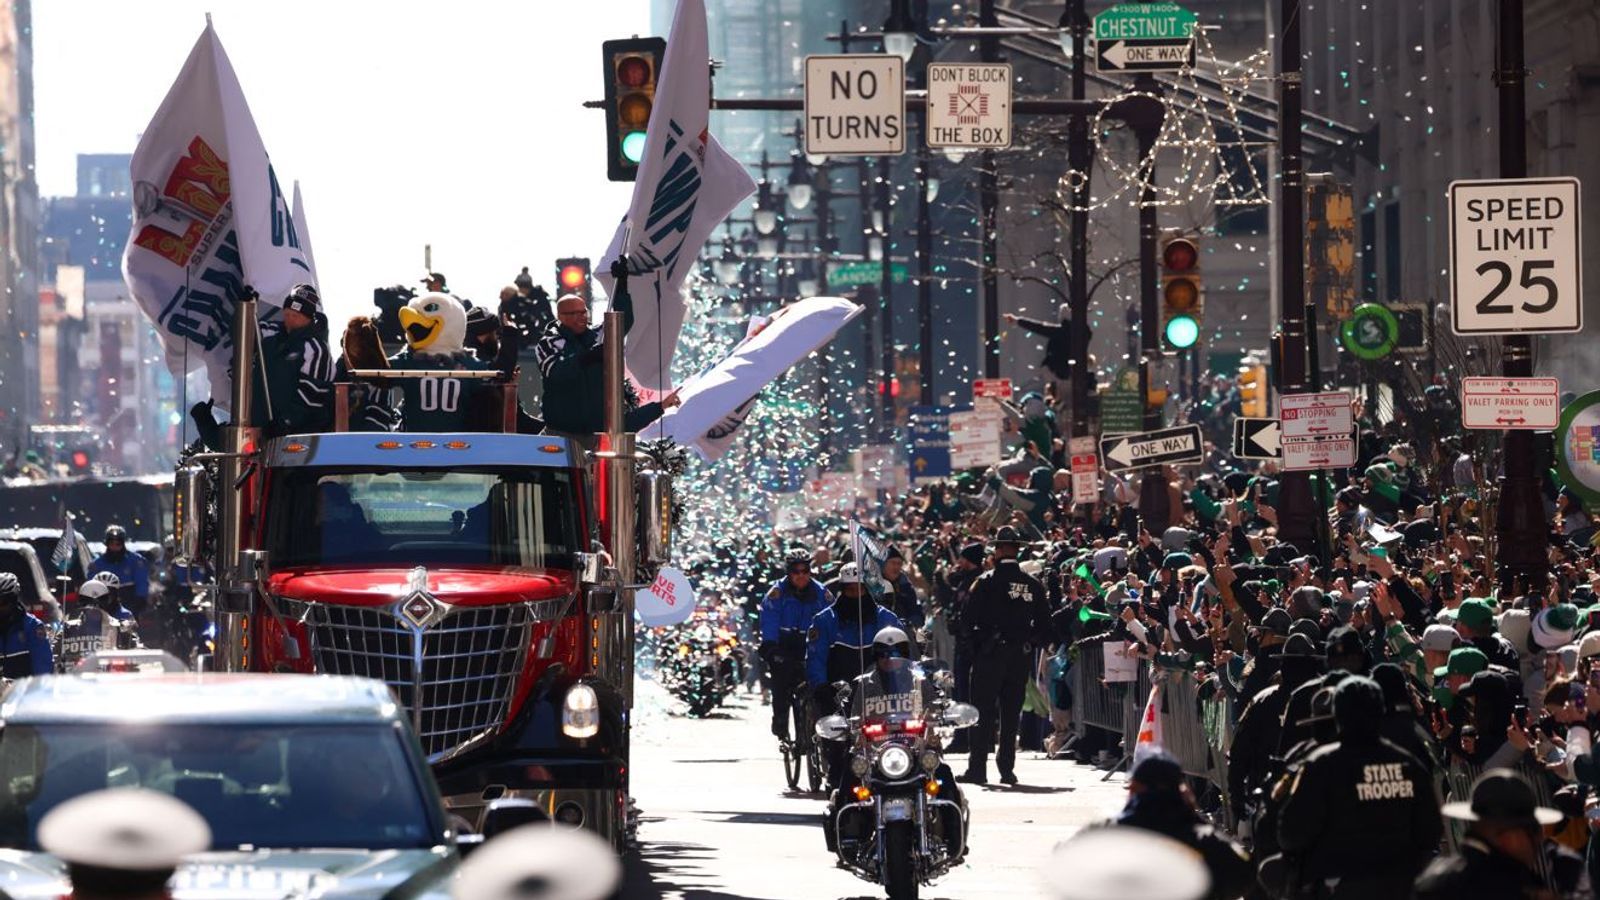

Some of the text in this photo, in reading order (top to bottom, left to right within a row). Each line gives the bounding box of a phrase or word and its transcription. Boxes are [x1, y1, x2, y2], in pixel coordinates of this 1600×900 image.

[1141, 4, 1151, 14] W
[1100, 17, 1177, 37] CHESTNUT
[1127, 47, 1184, 60] ONE WAY
[831, 70, 877, 99] NO
[969, 68, 1006, 81] BLOCK
[811, 115, 899, 139] TURNS
[934, 127, 1003, 143] THE BOX
[1467, 197, 1564, 222] SPEED
[189, 213, 228, 267] SUPER
[1477, 227, 1553, 251] LIMIT
[1475, 259, 1559, 315] 25
[420, 377, 461, 412] 00
[1468, 398, 1554, 406] VALET PARKING ONLY
[1284, 408, 1337, 419] NO STOPPING
[1131, 437, 1189, 457] ONE WAY
[650, 584, 676, 606] RTS
[63, 641, 110, 654] POLICE
[865, 690, 921, 706] PHILADELPH
[865, 697, 921, 716] POLIC
[1364, 763, 1403, 783] STATE
[1356, 780, 1414, 800] TROOPER
